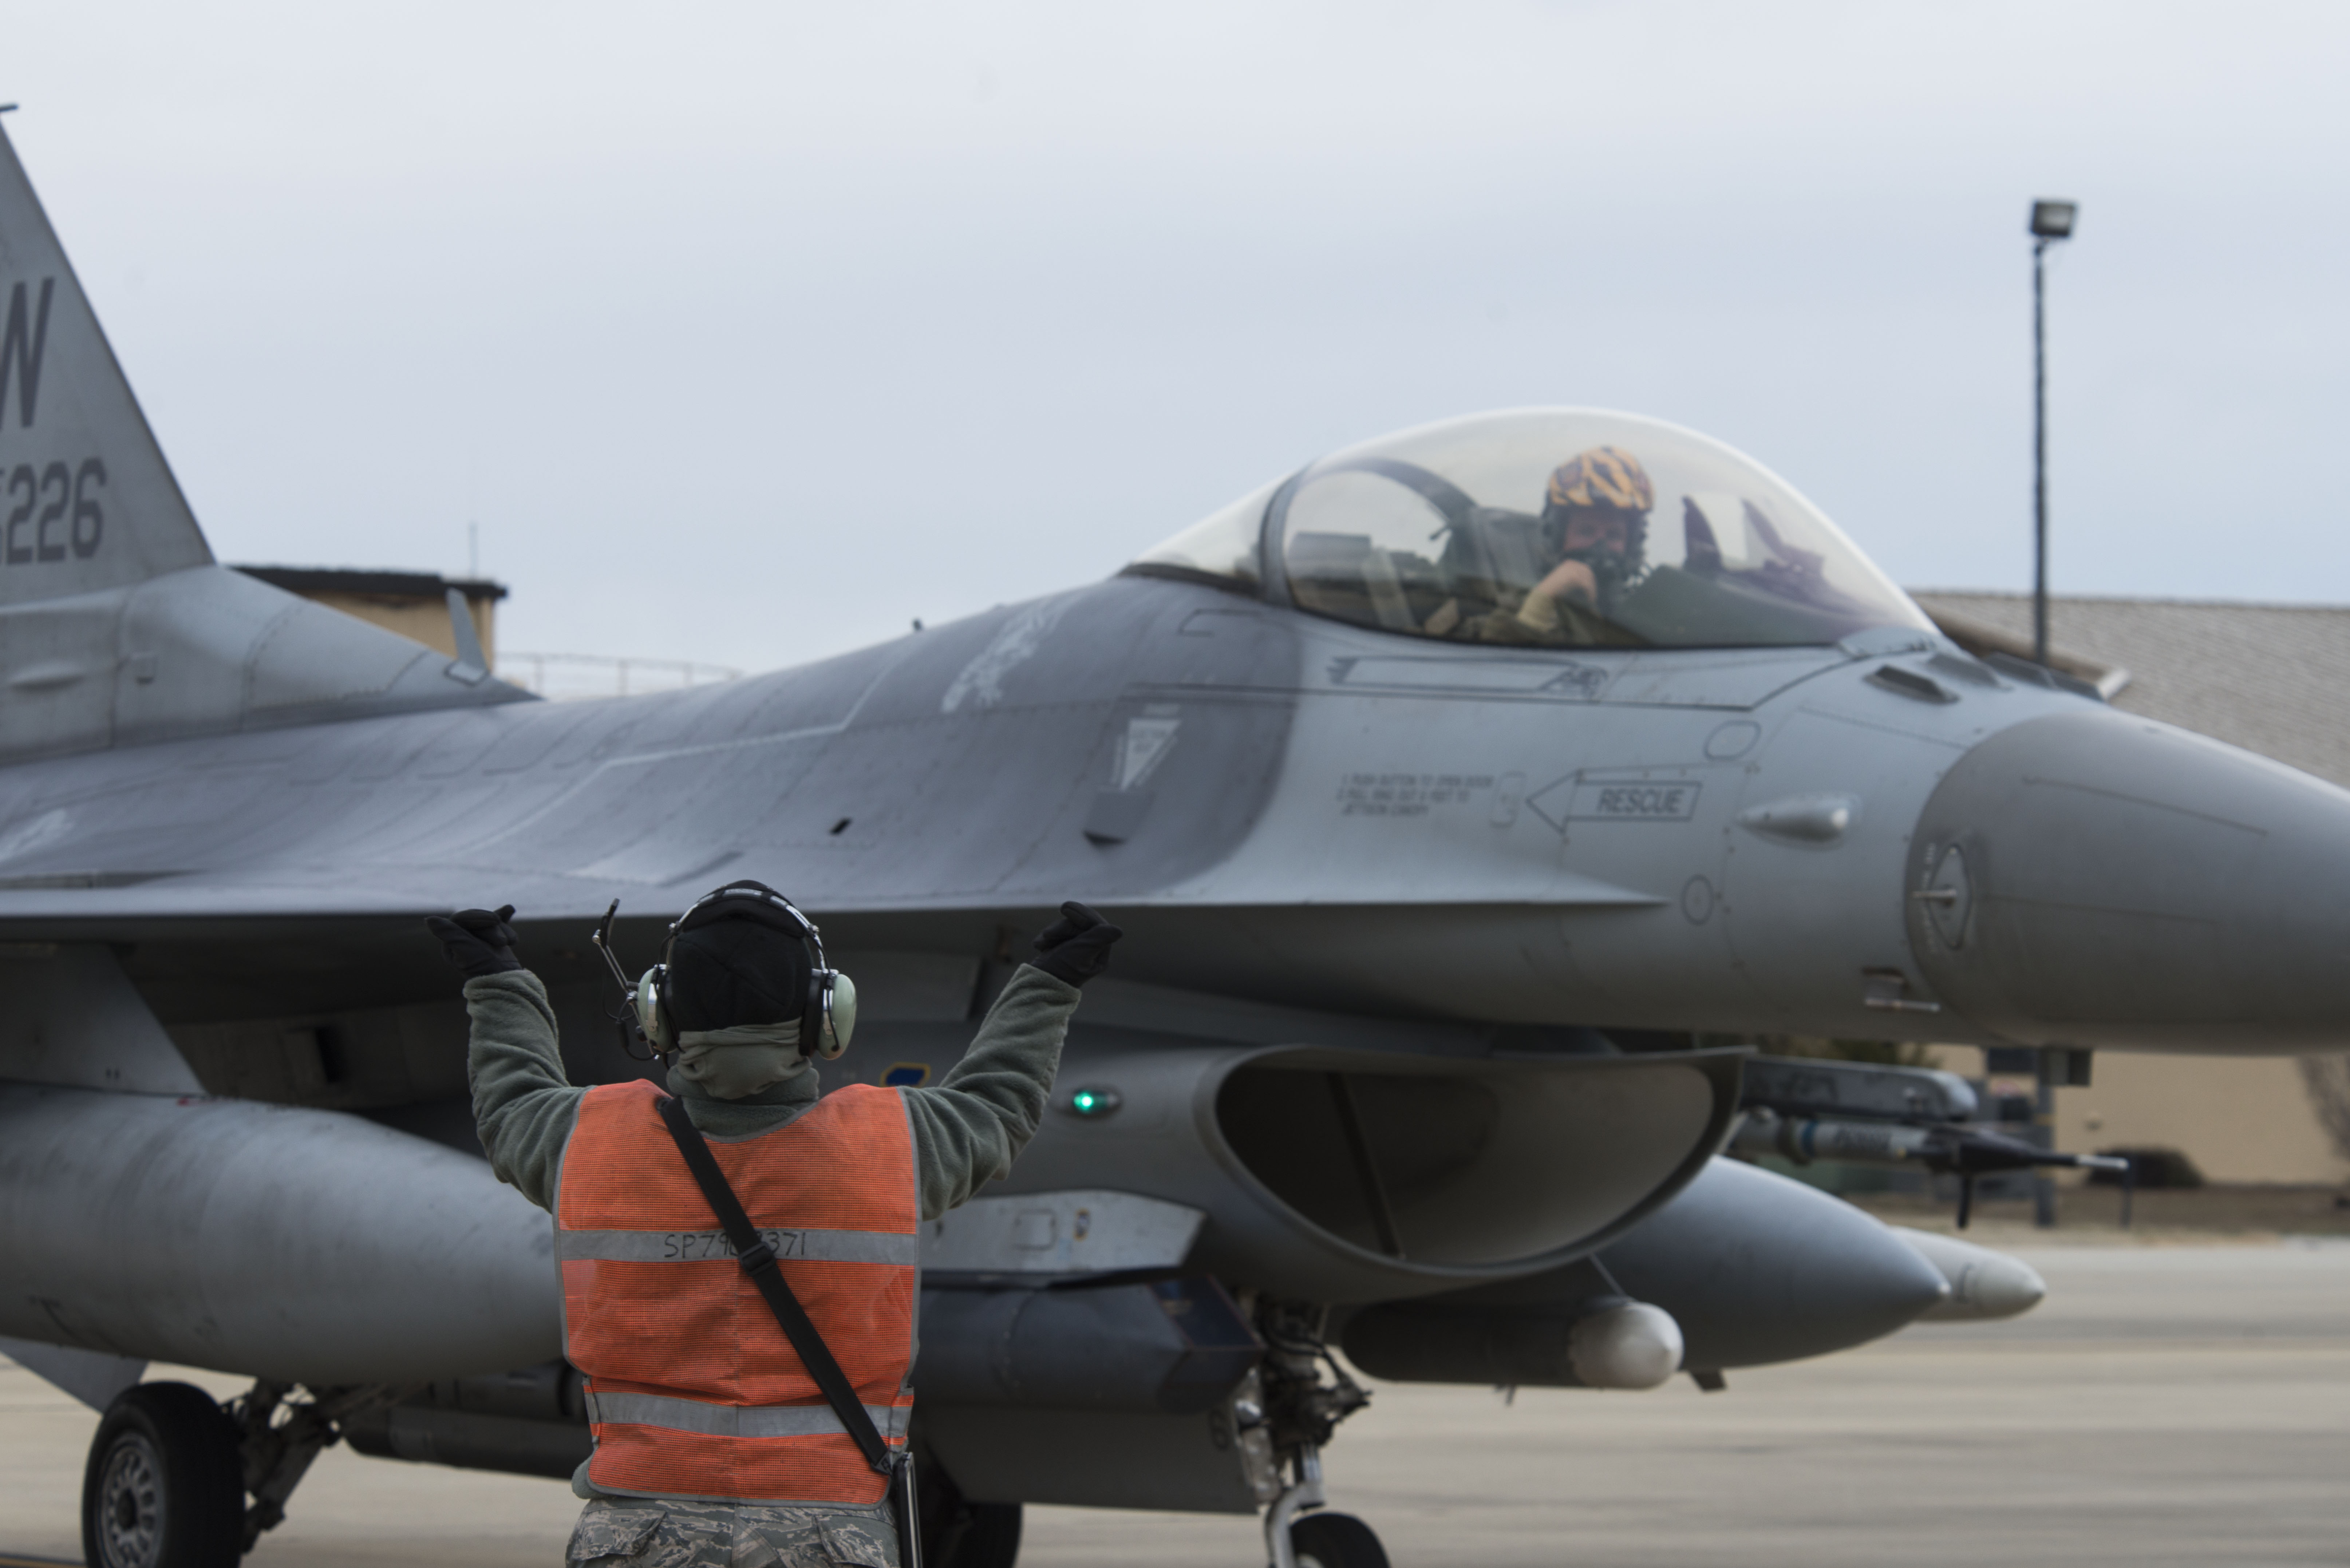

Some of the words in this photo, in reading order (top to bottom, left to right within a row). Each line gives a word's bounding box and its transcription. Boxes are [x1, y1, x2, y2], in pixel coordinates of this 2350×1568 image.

[0, 457, 107, 564] 226
[1596, 788, 1684, 814] RESCUE
[664, 1231, 806, 1258] SP79371
